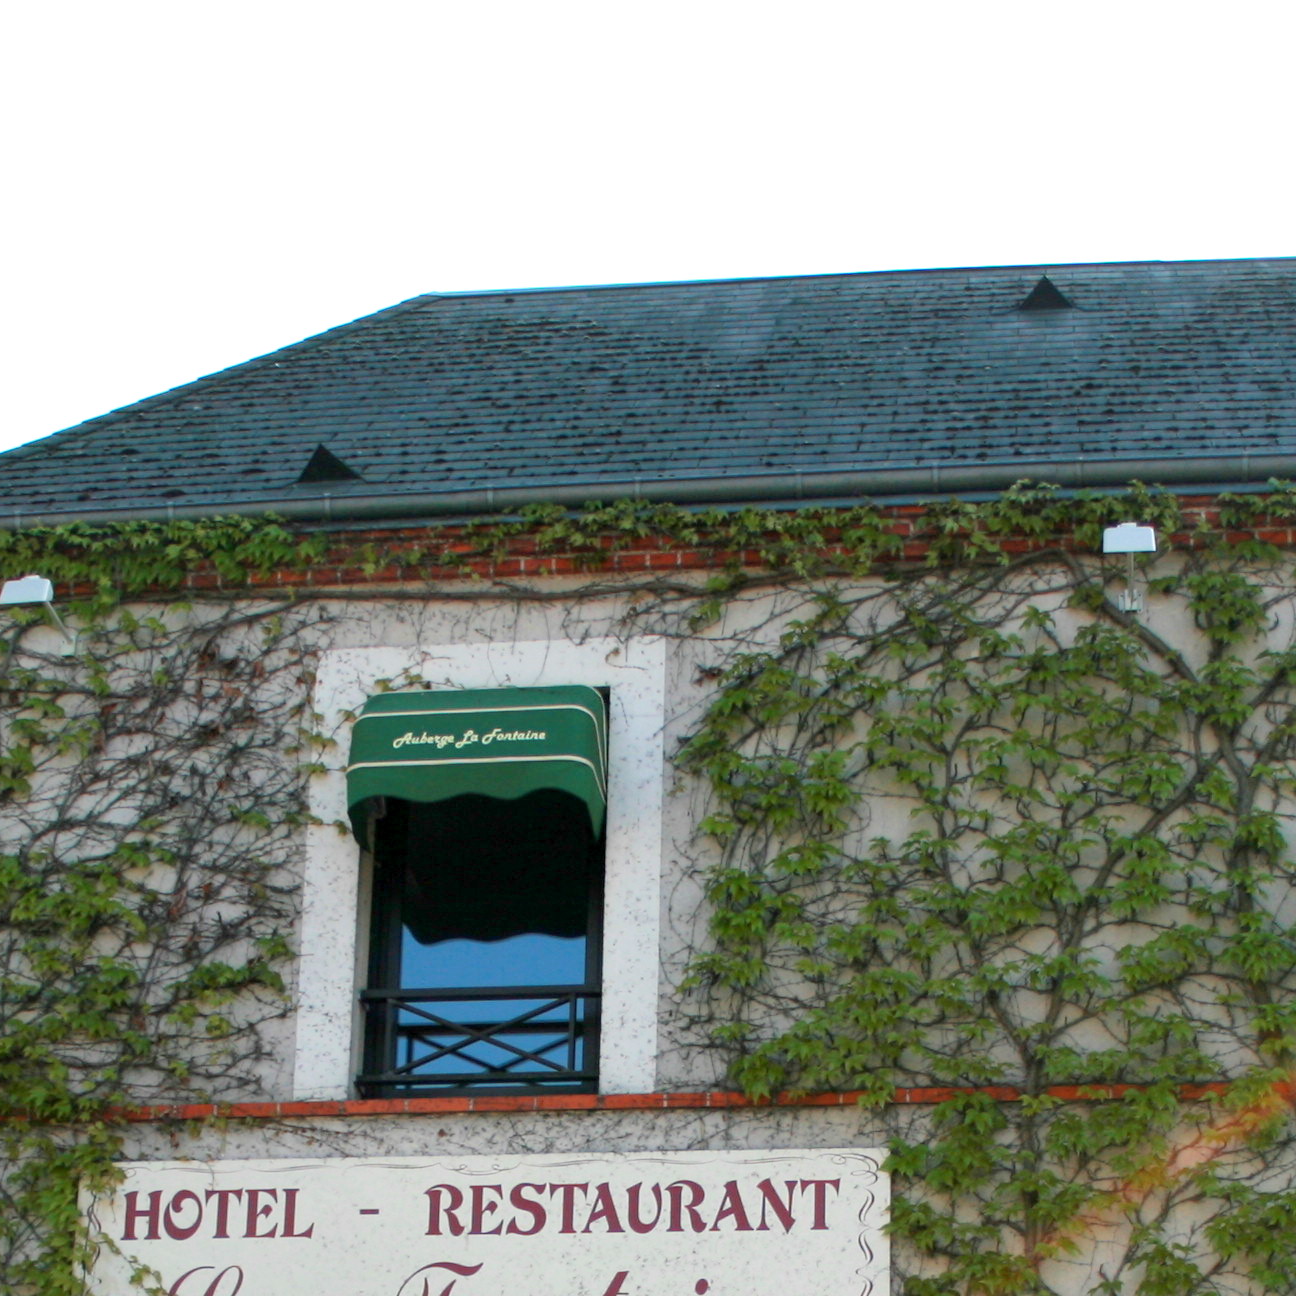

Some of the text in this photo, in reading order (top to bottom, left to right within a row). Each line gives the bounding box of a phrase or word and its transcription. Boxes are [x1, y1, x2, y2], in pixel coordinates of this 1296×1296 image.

[392, 727, 547, 749] Auberge La Fontaine
[119, 1187, 315, 1241] HOTEL
[423, 1177, 841, 1237] RESTAURANT
